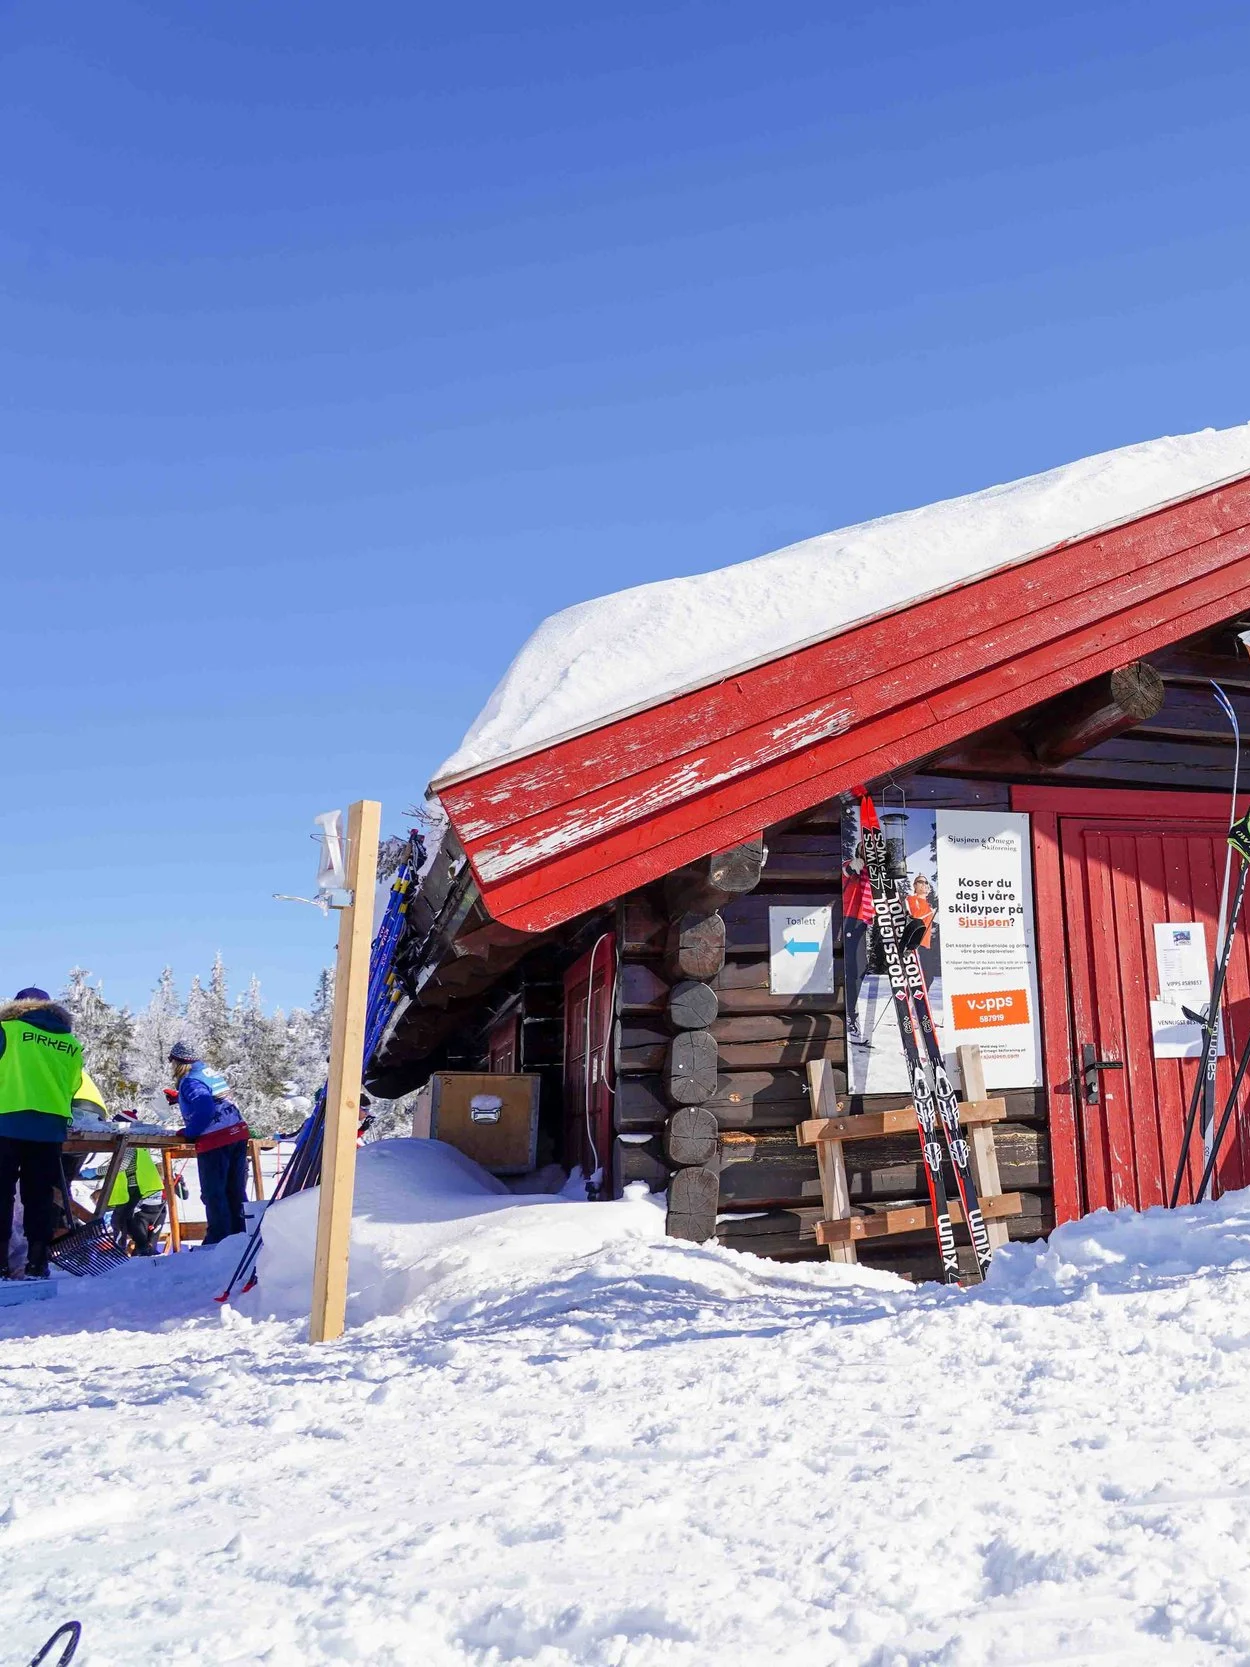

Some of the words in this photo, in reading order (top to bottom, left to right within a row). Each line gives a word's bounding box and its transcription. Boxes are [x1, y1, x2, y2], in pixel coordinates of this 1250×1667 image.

[948, 835, 980, 844] Sjusjøen
[988, 836, 1015, 845] Omegn
[981, 843, 1017, 852] Skiforening
[958, 877, 993, 888] Koser
[997, 878, 1012, 888] du
[956, 890, 978, 902] deg
[981, 890, 985, 900] i
[988, 889, 1015, 901] våre
[948, 903, 1005, 916] skiløyper
[1008, 902, 1024, 916] på
[786, 917, 816, 926] Toalett
[958, 916, 1015, 928] Sjusjøen?
[873, 892, 908, 988] ROSSIGNOL
[889, 892, 923, 988] ROSGNOL
[23, 1032, 78, 1057] BIRKEN
